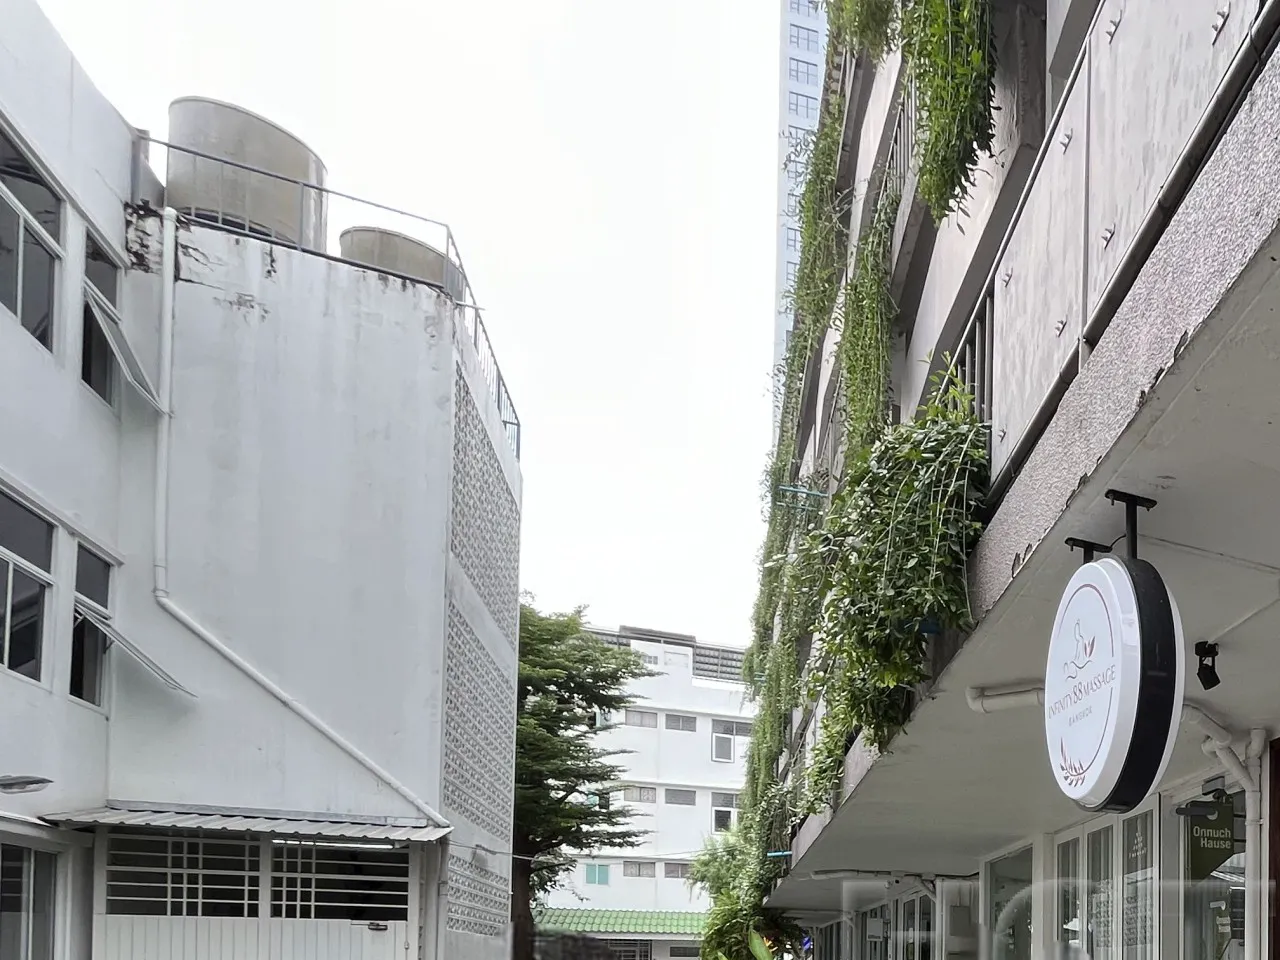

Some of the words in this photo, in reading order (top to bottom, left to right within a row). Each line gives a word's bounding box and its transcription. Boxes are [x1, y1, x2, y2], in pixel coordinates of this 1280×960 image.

[1082, 665, 1117, 700] MASSAGE
[1193, 826, 1231, 839] Onnuch
[1200, 836, 1232, 849] Hause
